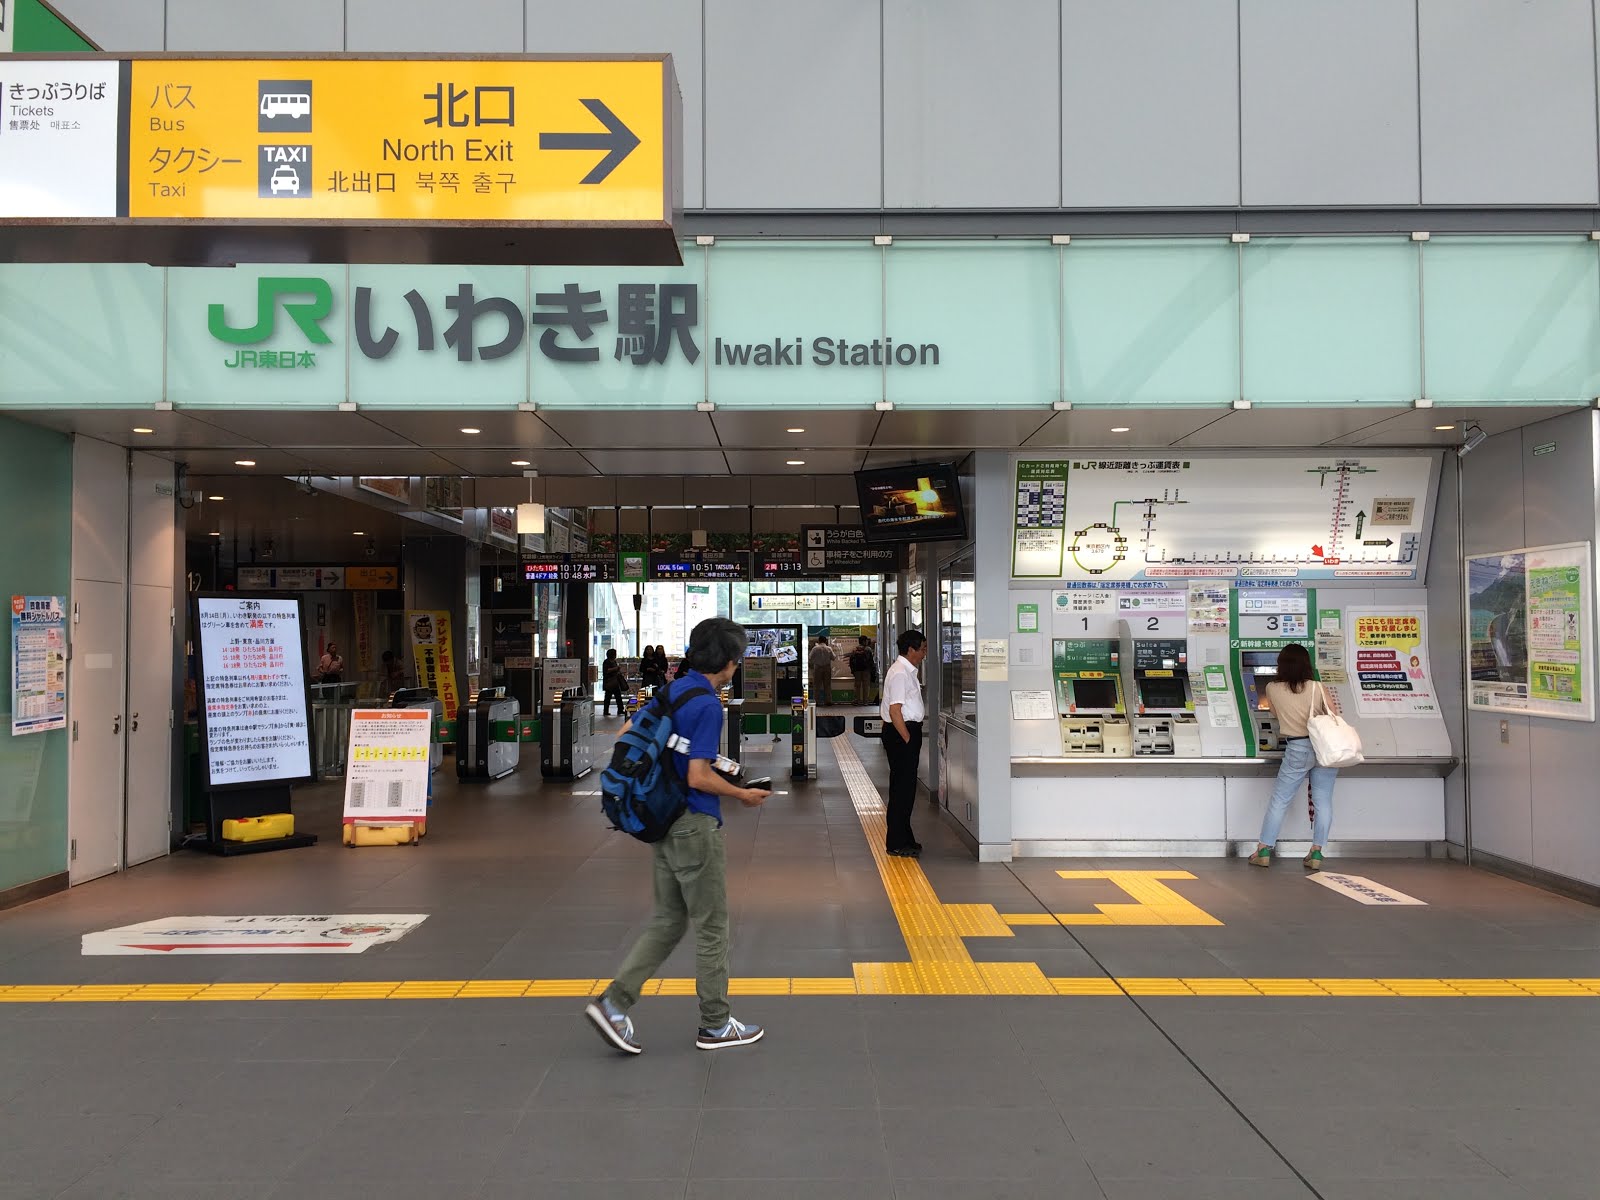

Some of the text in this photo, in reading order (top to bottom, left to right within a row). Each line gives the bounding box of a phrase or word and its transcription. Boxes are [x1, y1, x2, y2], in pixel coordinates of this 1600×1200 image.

[9, 81, 107, 101] きっぷうりば
[150, 84, 196, 110] バス
[10, 105, 54, 116] Tickets
[423, 82, 515, 128] 北口
[9, 120, 41, 131] 售票处
[50, 120, 81, 131] 매표소
[150, 117, 186, 131] Bus
[263, 147, 307, 162] TAXI
[383, 139, 514, 162] North Exit
[149, 146, 243, 174] タクシー
[149, 182, 187, 197] Taxi
[327, 170, 517, 194] 北出口 북쪽 출구
[207, 276, 333, 345] JR
[354, 283, 701, 367] いわき駅
[714, 336, 941, 366] Iwaki Station
[224, 350, 316, 370] JR東日本
[825, 550, 893, 559] 車椅子をご利用の方
[560, 564, 582, 572] 10:17
[583, 564, 597, 572] 品川
[692, 563, 713, 571] 10:51
[734, 563, 740, 571] 4
[780, 563, 802, 571] 13:13
[560, 572, 582, 580] 10:48
[583, 572, 597, 580] 水戸
[603, 572, 608, 580] 3
[239, 601, 261, 610] ご案内
[20, 611, 61, 622] 無料シャトルバス
[1081, 617, 1088, 631] 1
[1146, 616, 1159, 631] 2
[1266, 616, 1279, 631] 3
[1240, 640, 1279, 648] 新幹線・特急
